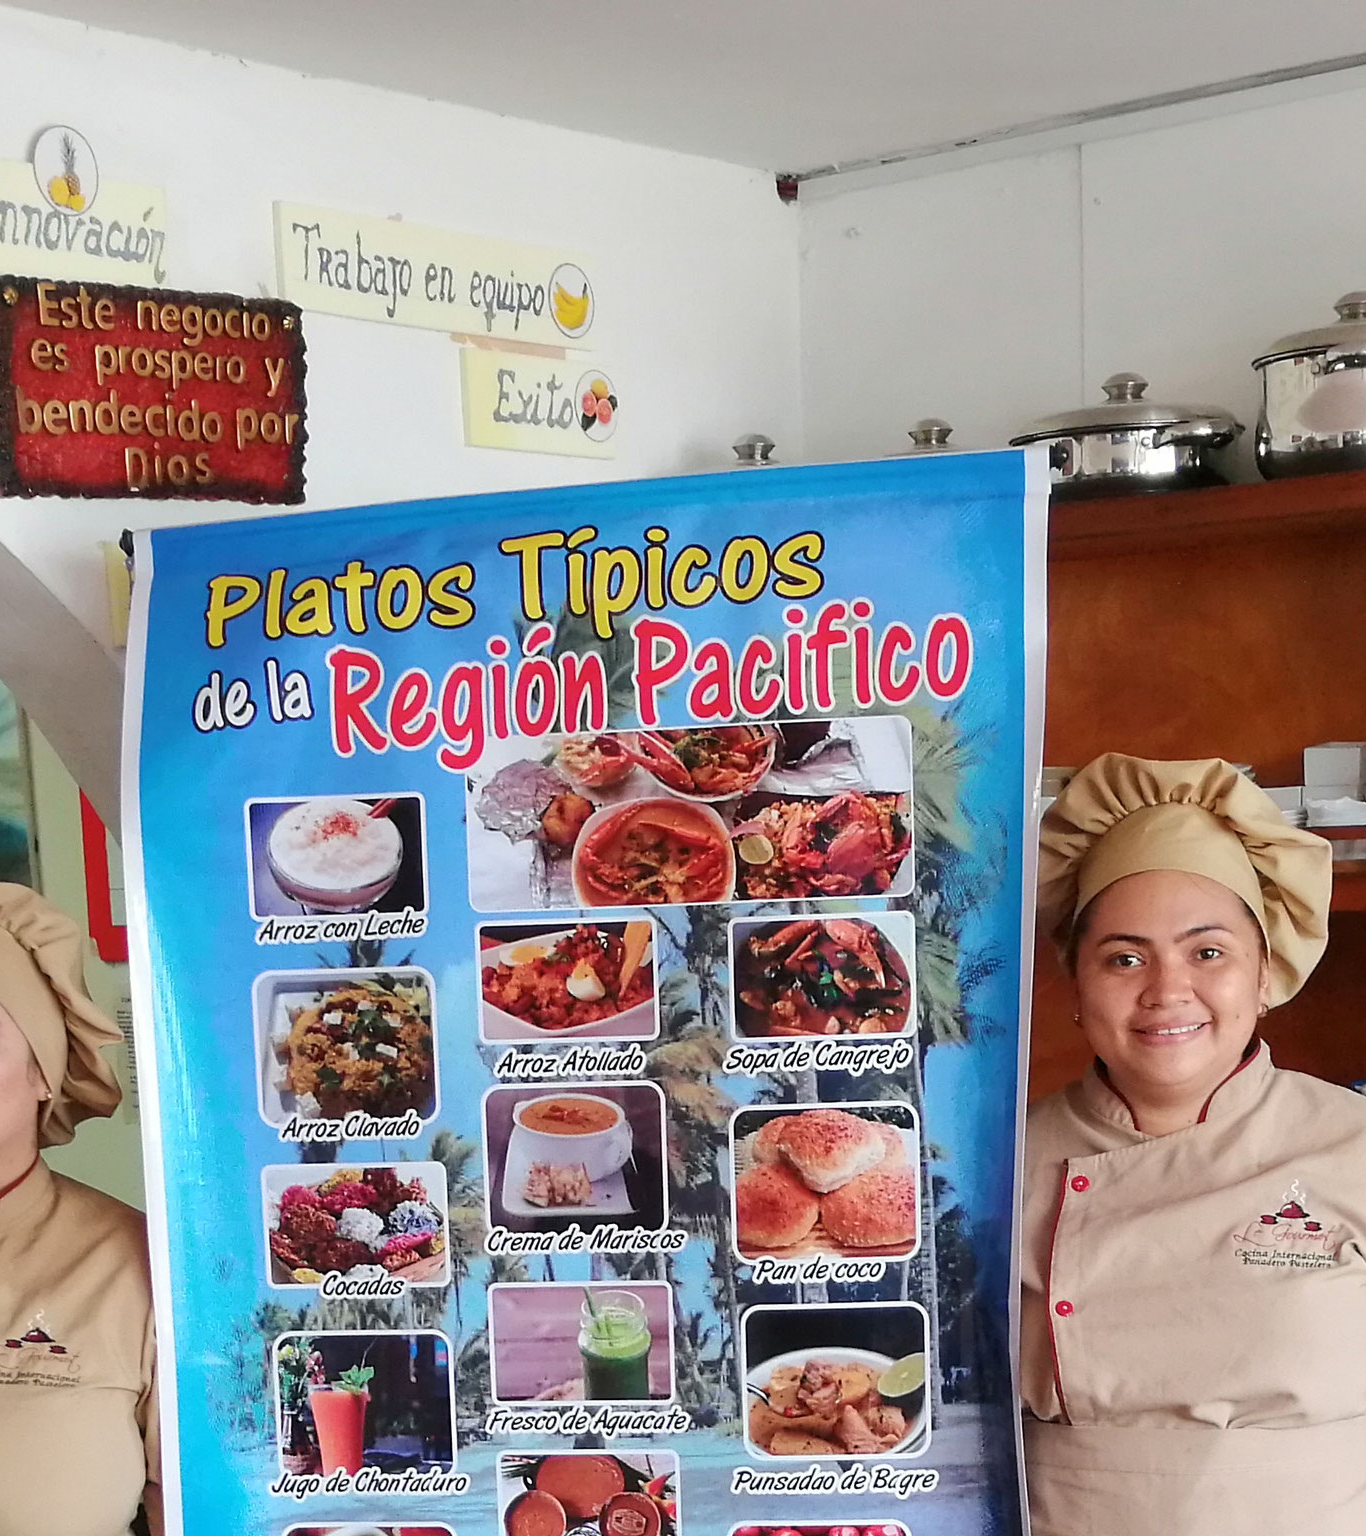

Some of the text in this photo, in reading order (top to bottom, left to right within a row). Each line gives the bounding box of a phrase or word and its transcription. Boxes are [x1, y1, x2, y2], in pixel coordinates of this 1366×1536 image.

[292, 223, 545, 331] Trabajo en equipo
[36, 282, 271, 346] Este negocio
[31, 337, 284, 398] es prospero y
[493, 368, 574, 429] Exito
[16, 386, 299, 450] bendecido por
[125, 442, 211, 488] Dios
[206, 528, 824, 649] Platos Típicos
[194, 671, 254, 732] de
[268, 660, 313, 724] la
[327, 627, 609, 772] Región
[259, 911, 425, 942] Arroz con Leche
[499, 1049, 644, 1075] Arroz Atollado
[726, 1044, 910, 1075] Sopa de Cangrejo
[282, 1113, 420, 1138] Arroz Clavado
[488, 1228, 684, 1251] Crema de Mariscos
[1272, 1223, 1336, 1251] Gourmet
[756, 1256, 882, 1280] Pan de coco
[1235, 1248, 1335, 1262] Cocina Internacional
[1242, 1257, 1332, 1269] Panadero Pastelero
[322, 1273, 405, 1296] Cocadas
[489, 1409, 687, 1438] Fresco de Aguacate
[272, 1471, 468, 1499] Jugo de Chontaduro
[734, 1467, 936, 1497] Punsadao de Bagre
